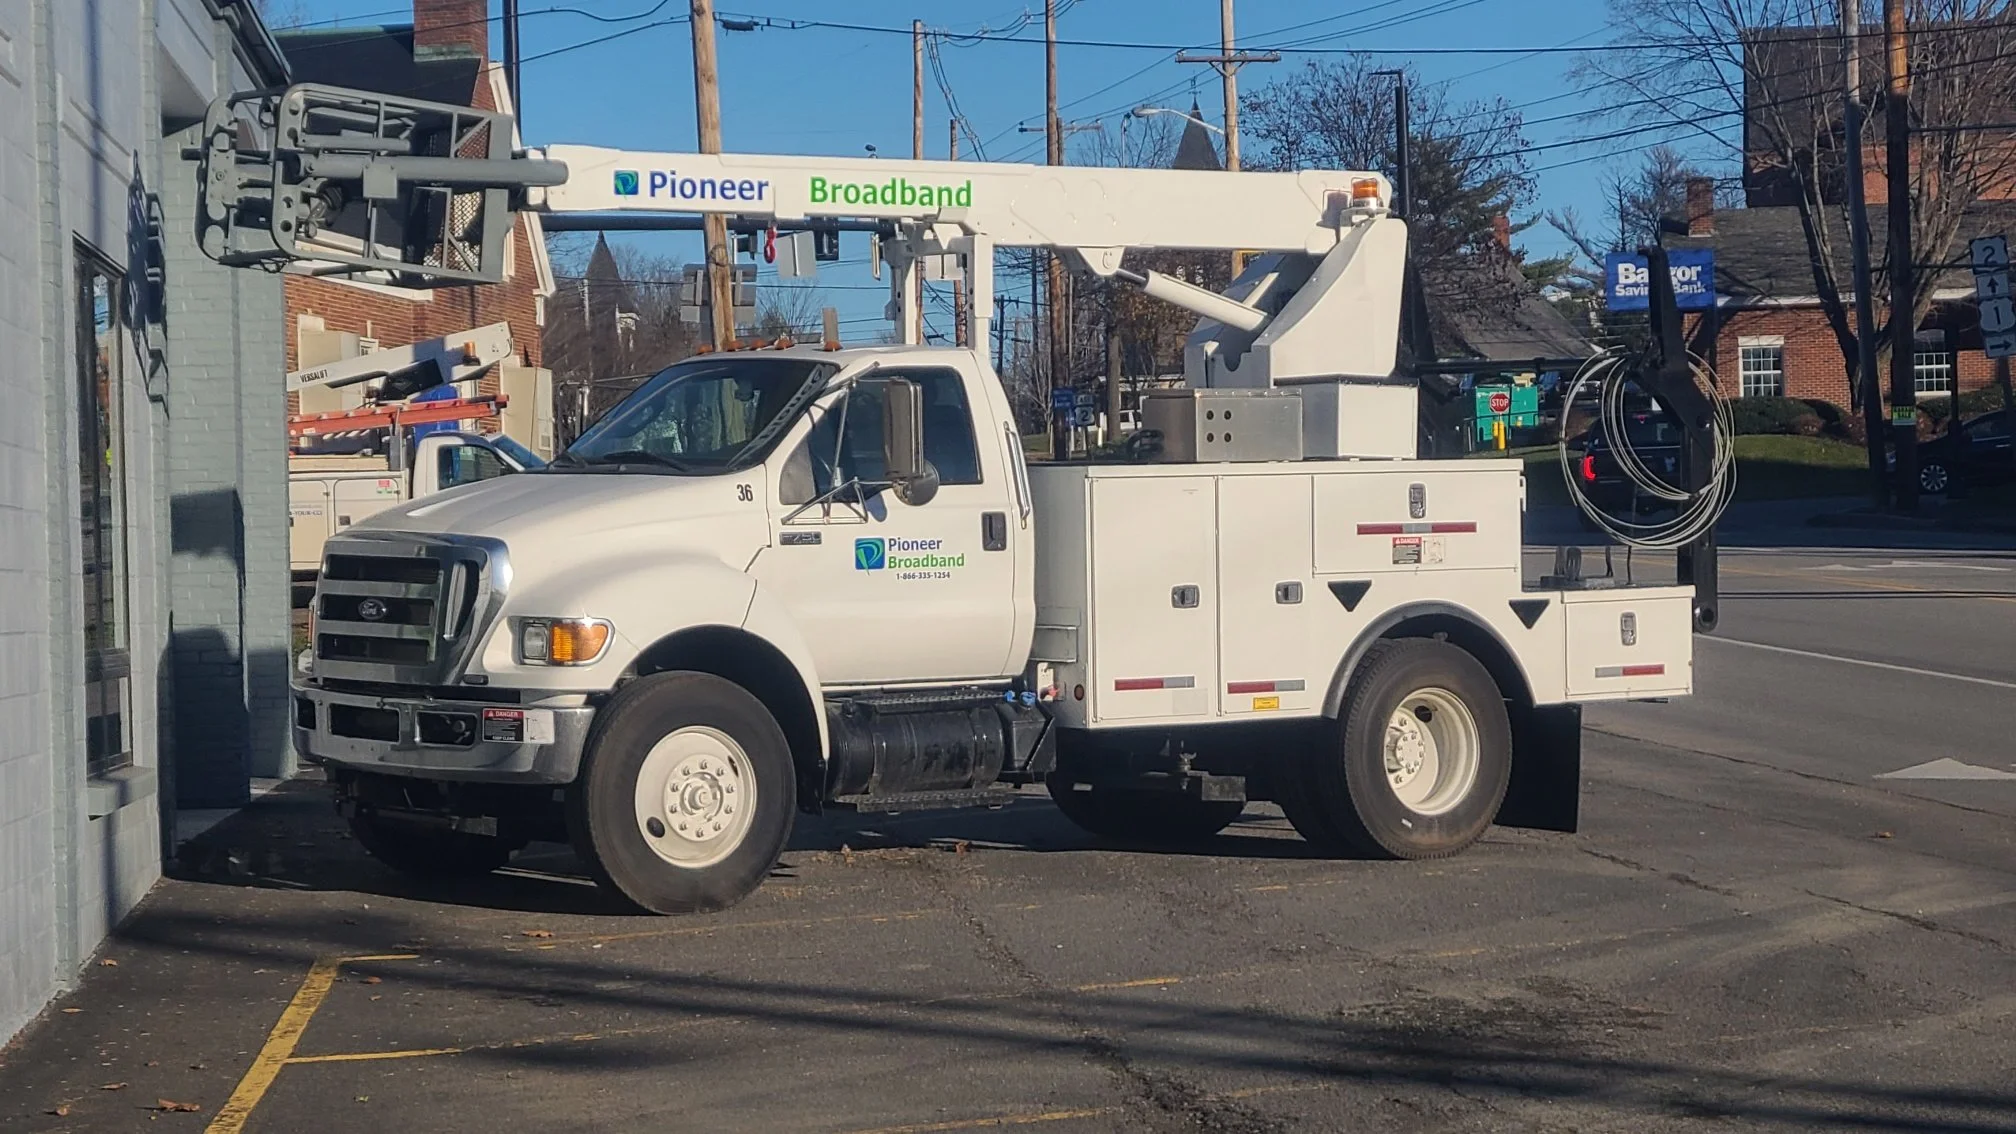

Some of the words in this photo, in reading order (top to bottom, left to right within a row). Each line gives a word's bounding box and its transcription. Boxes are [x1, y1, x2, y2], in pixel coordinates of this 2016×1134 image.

[649, 169, 769, 201] Pioneer
[809, 175, 973, 208] Broadband
[1982, 245, 1996, 267] 2
[1617, 263, 1702, 284] Baor
[1993, 306, 2001, 326] 1
[1491, 398, 1509, 408] STOP
[1081, 409, 1089, 422] 2
[736, 484, 753, 502] 36
[888, 537, 943, 552] Pioneer
[888, 553, 965, 569] Broadband
[896, 571, 951, 580] 1-866-335-1254
[495, 710, 519, 718] DANGER
